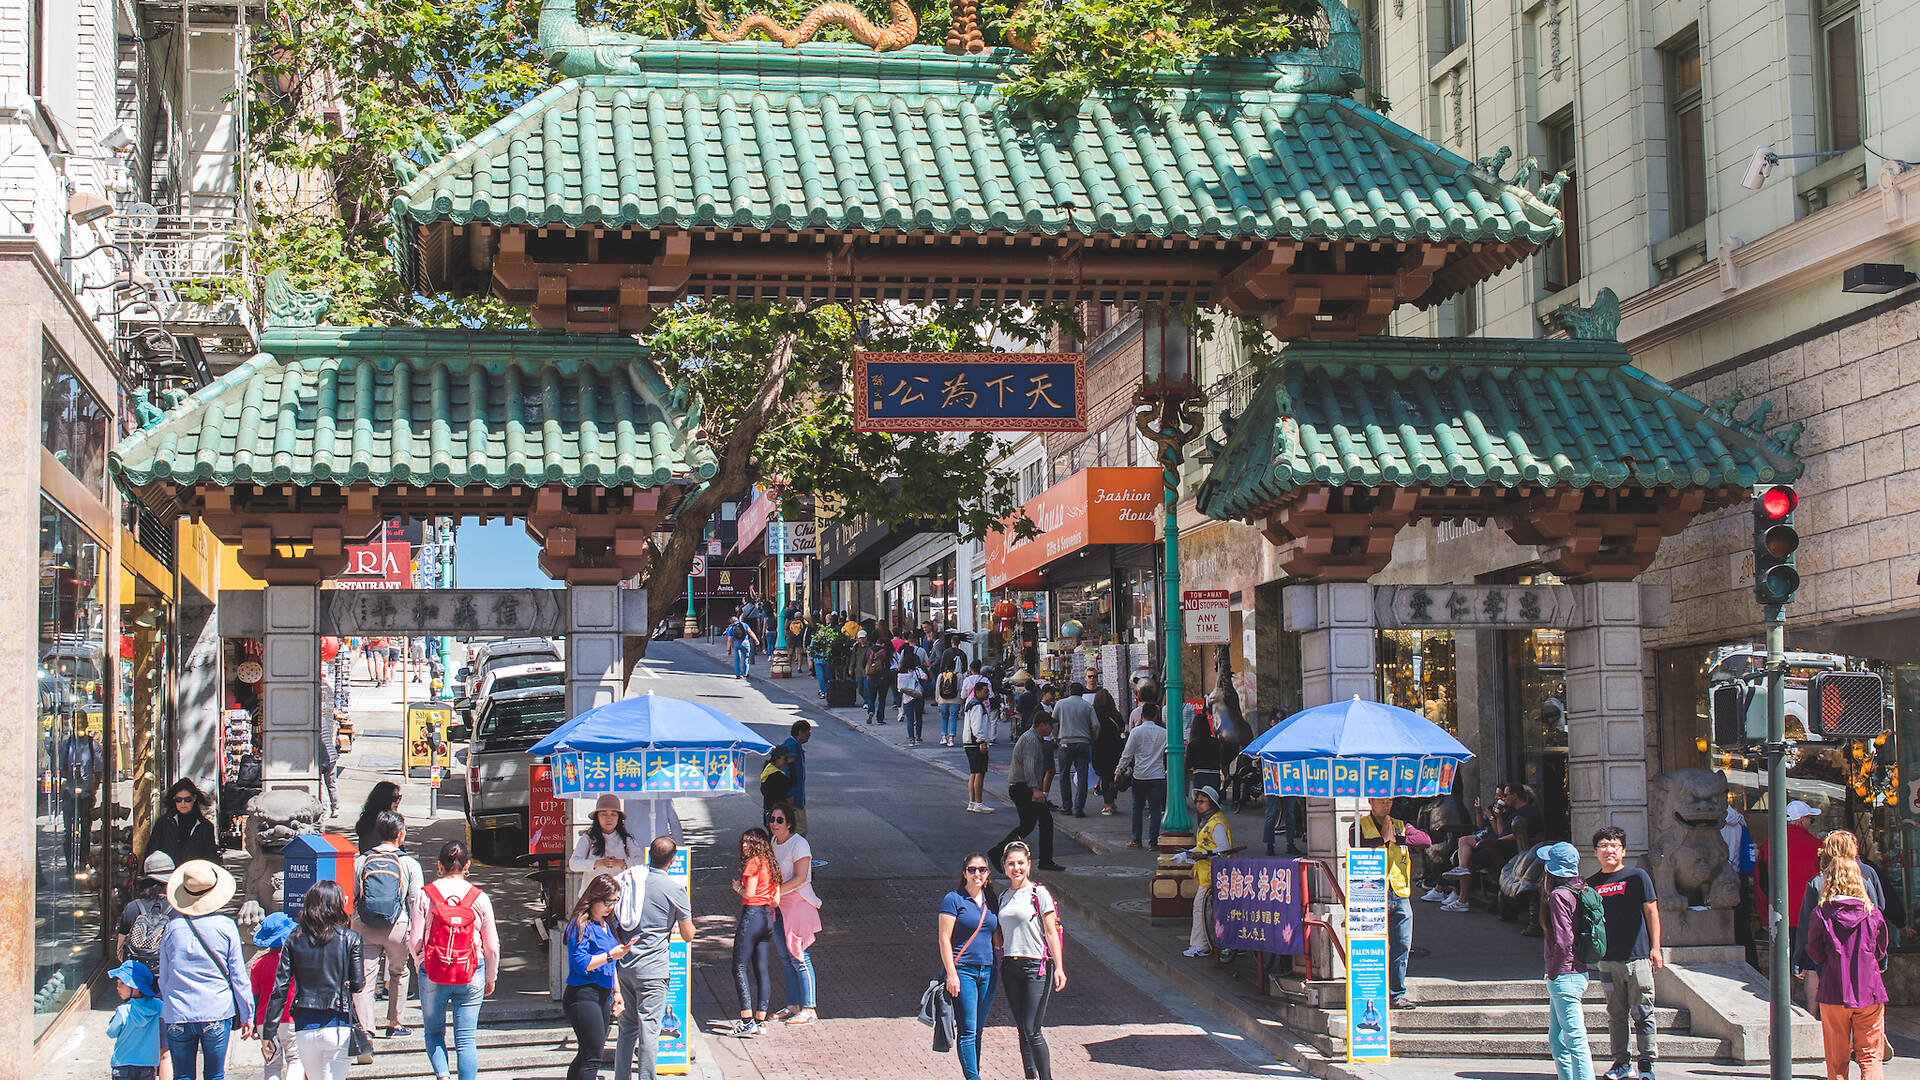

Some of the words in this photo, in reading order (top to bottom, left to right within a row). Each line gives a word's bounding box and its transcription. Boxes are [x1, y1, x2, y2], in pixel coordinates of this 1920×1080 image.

[888, 372, 1063, 410] 天下為公
[1094, 488, 1151, 504] Fashion
[1118, 508, 1153, 521] Hous
[1036, 502, 1065, 541] House
[1185, 600, 1198, 610] NO
[1200, 600, 1228, 609] STOPPING
[1197, 614, 1217, 622] ANY
[1196, 624, 1219, 632] TIME
[584, 755, 728, 783] 法輪大法好
[1283, 764, 1300, 779] Fa
[1307, 765, 1328, 780] Lun
[1335, 766, 1358, 780] Da
[1368, 766, 1389, 780] Fa
[1400, 765, 1414, 779] is
[540, 801, 558, 812] UP
[533, 815, 557, 826] 70%
[290, 864, 309, 872] POLICE
[669, 951, 686, 959] DAFA
[1351, 948, 1370, 956] FALUN
[1370, 948, 1385, 956] DAFA
